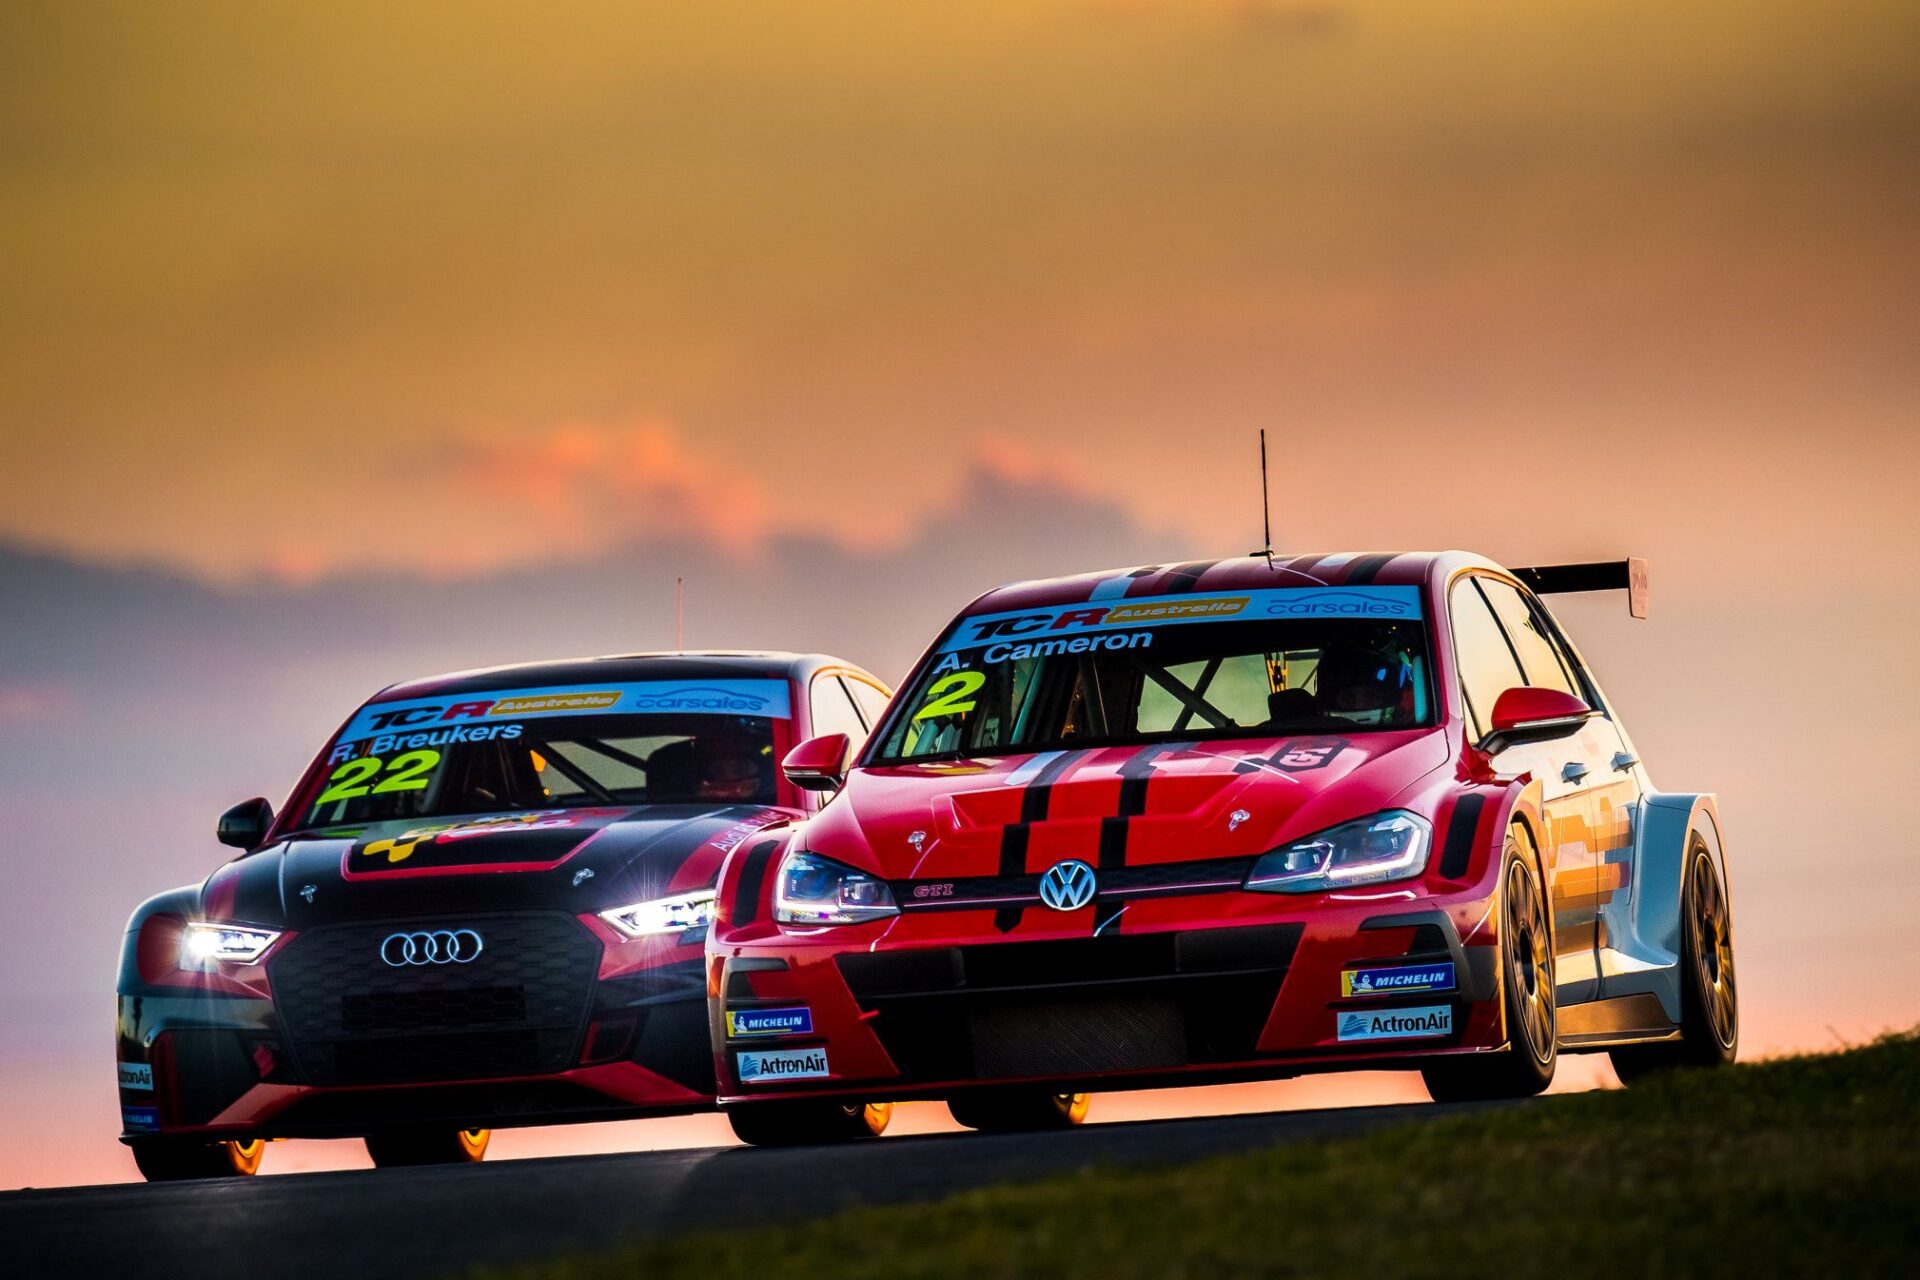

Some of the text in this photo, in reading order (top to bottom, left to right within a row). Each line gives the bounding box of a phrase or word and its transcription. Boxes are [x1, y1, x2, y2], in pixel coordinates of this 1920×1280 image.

[1266, 600, 1405, 615] carsales
[971, 602, 1240, 641] TCR Australia
[932, 631, 1152, 674] A. Cameron
[636, 697, 763, 711] carsales
[913, 670, 986, 720] 2
[370, 700, 495, 732] TCR
[327, 724, 523, 766] R. Breukers
[316, 749, 440, 805] 22
[913, 883, 955, 898] GTI
[1375, 972, 1446, 987] MICHELIN
[749, 1016, 802, 1028] MICHELIN
[1371, 1011, 1449, 1033] ActronAir
[760, 1053, 826, 1075] ActronAir
